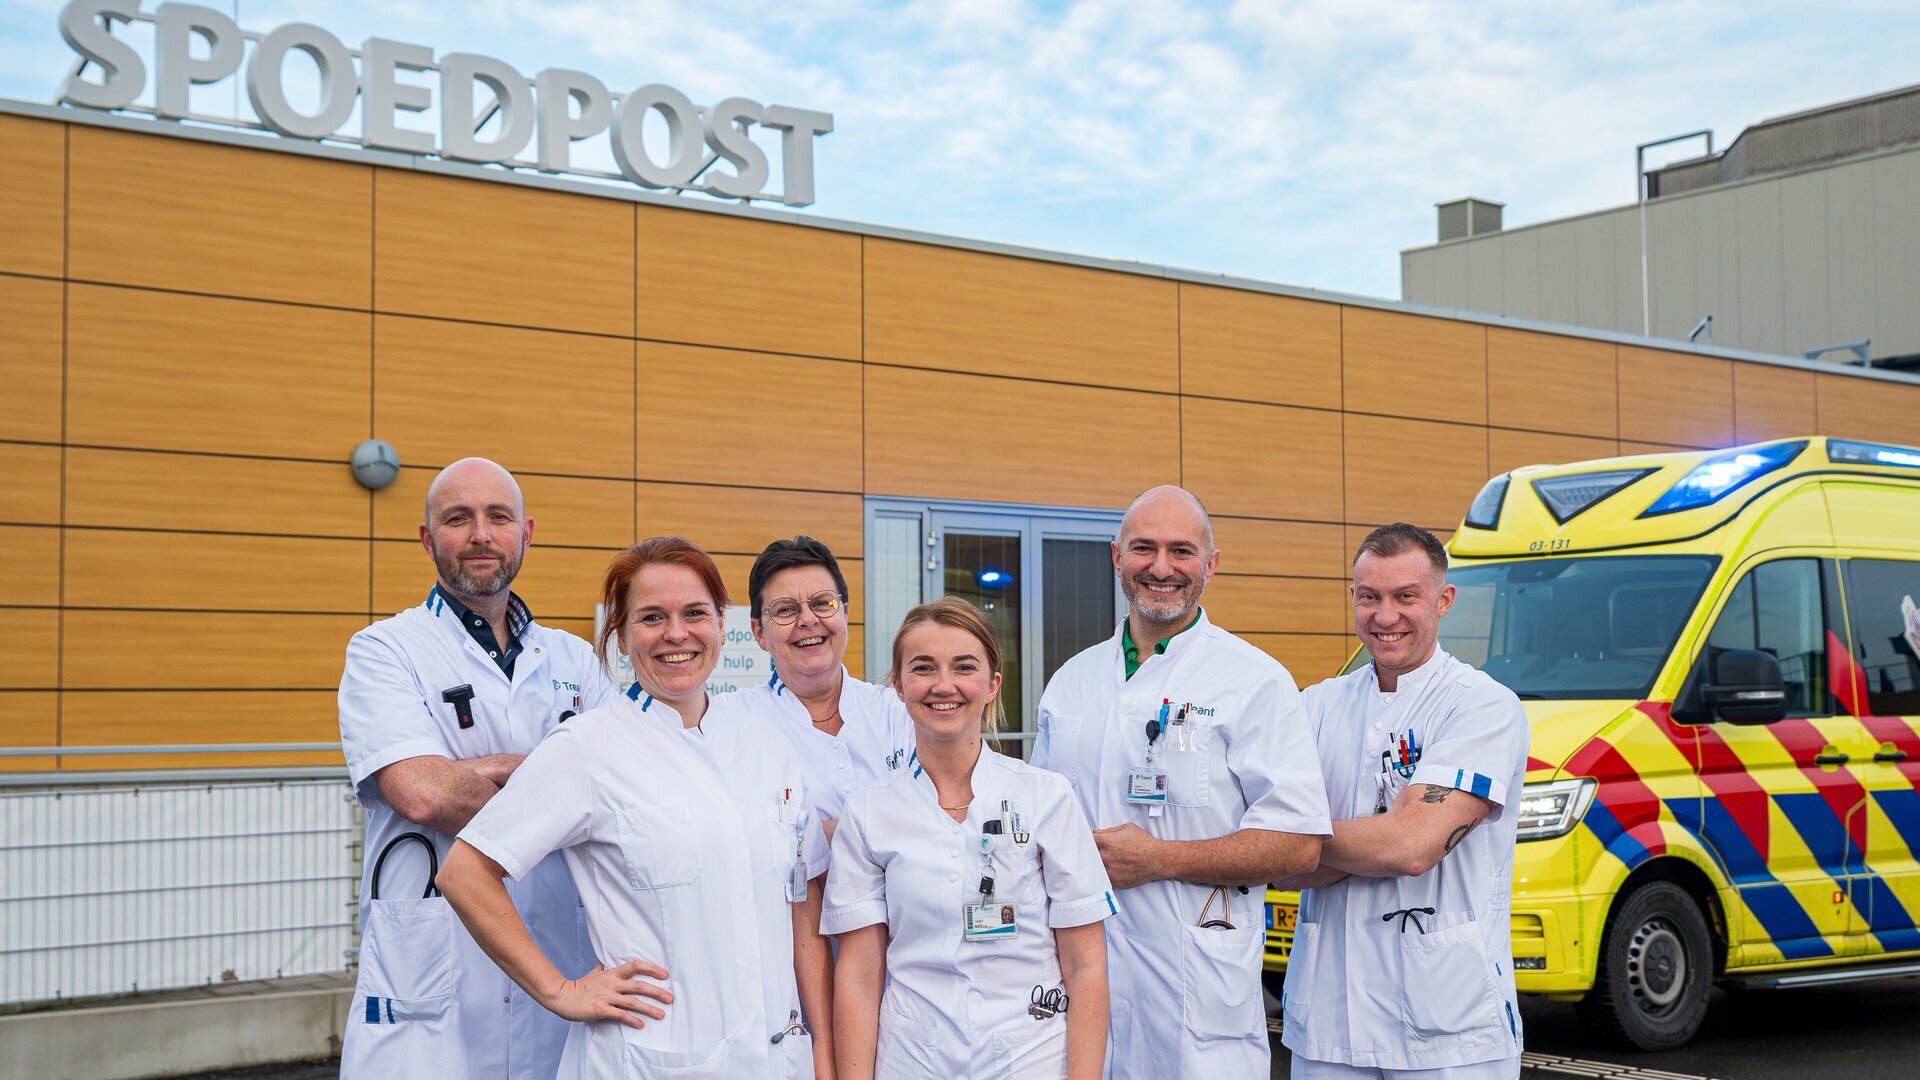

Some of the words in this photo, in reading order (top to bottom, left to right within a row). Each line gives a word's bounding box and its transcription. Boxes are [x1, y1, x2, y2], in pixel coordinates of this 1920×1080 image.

[58, 0, 834, 208] SPOEDPOST
[1529, 538, 1571, 551] 03-131
[723, 656, 754, 671] hulp
[1181, 703, 1215, 717] Teant
